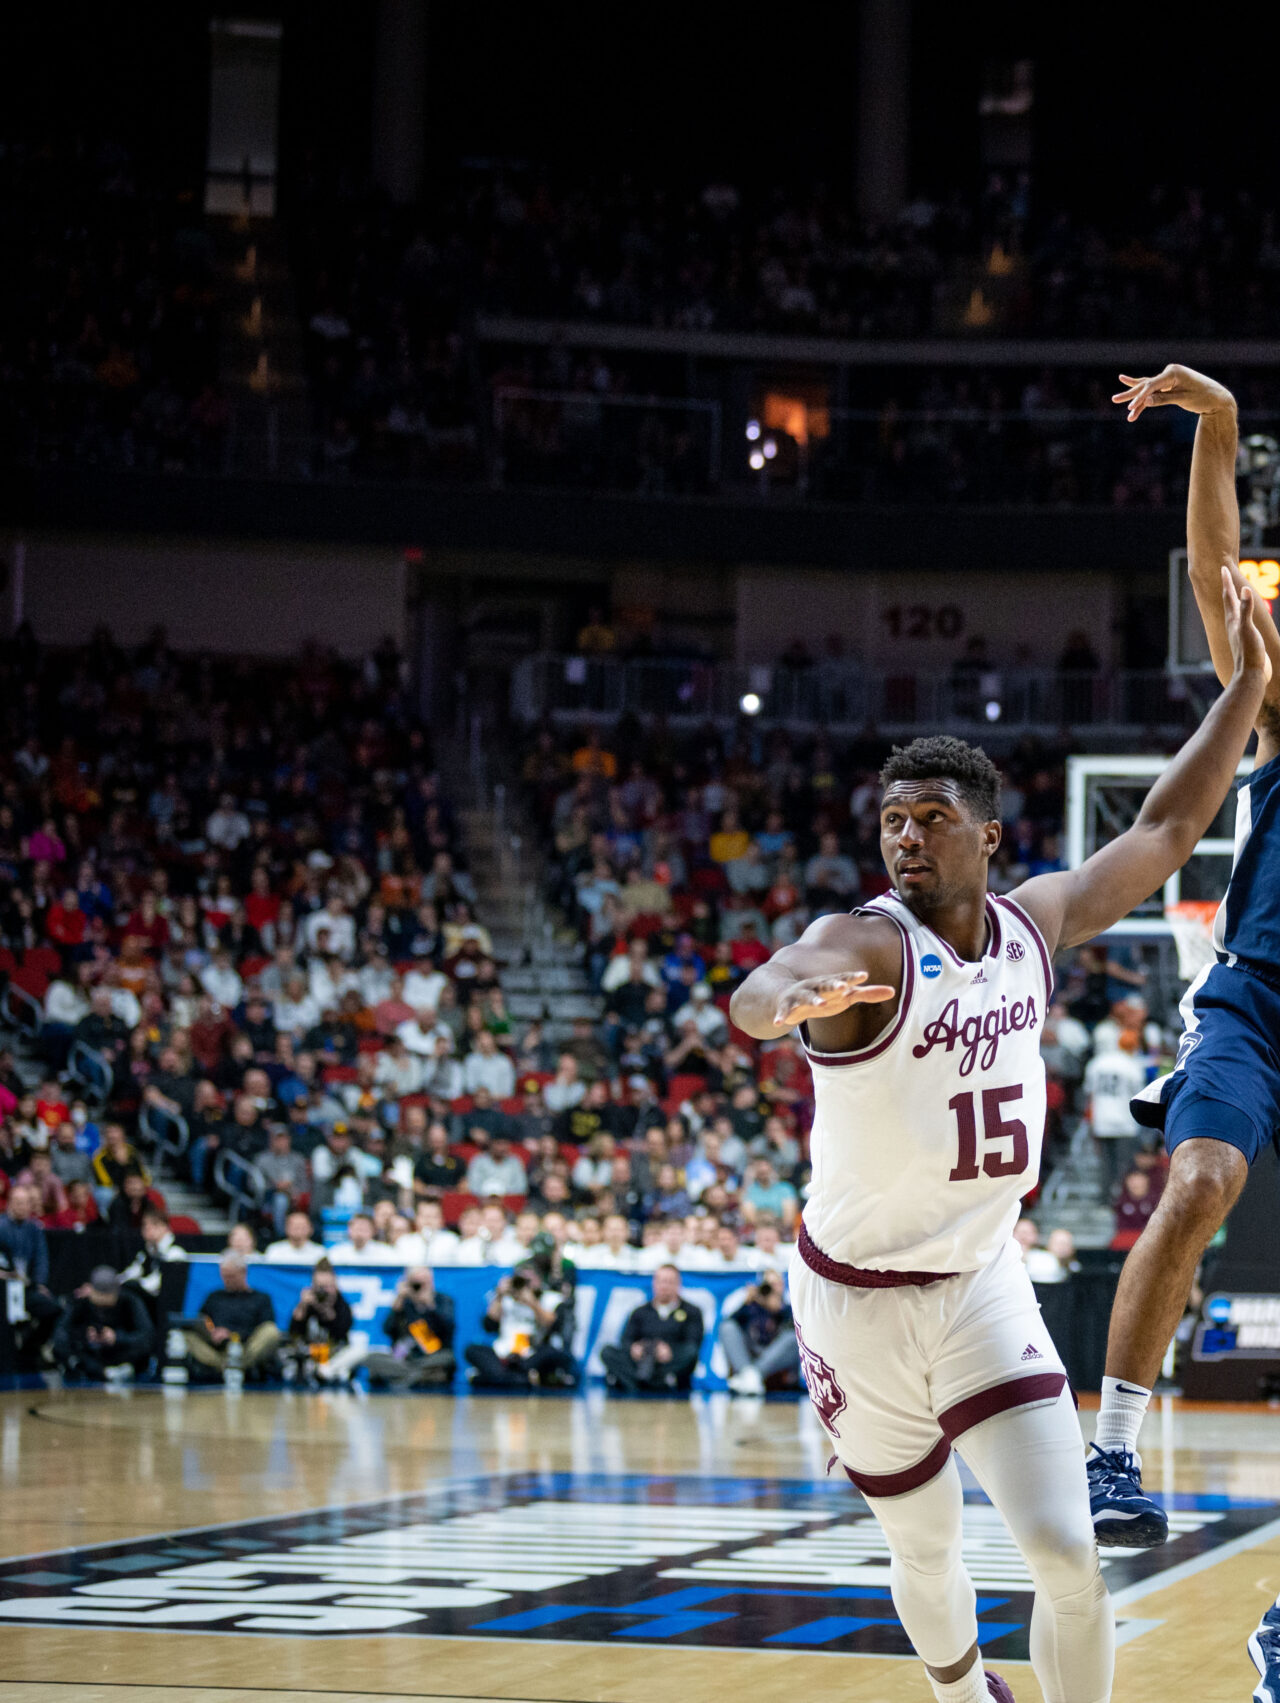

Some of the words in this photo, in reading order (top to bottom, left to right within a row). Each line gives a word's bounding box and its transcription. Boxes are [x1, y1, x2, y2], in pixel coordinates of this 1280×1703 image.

[884, 605, 965, 639] 120
[1006, 942, 1024, 960] SEC
[923, 965, 942, 973] NCAA
[912, 995, 1038, 1077] Aggies
[949, 1083, 1029, 1181] 15
